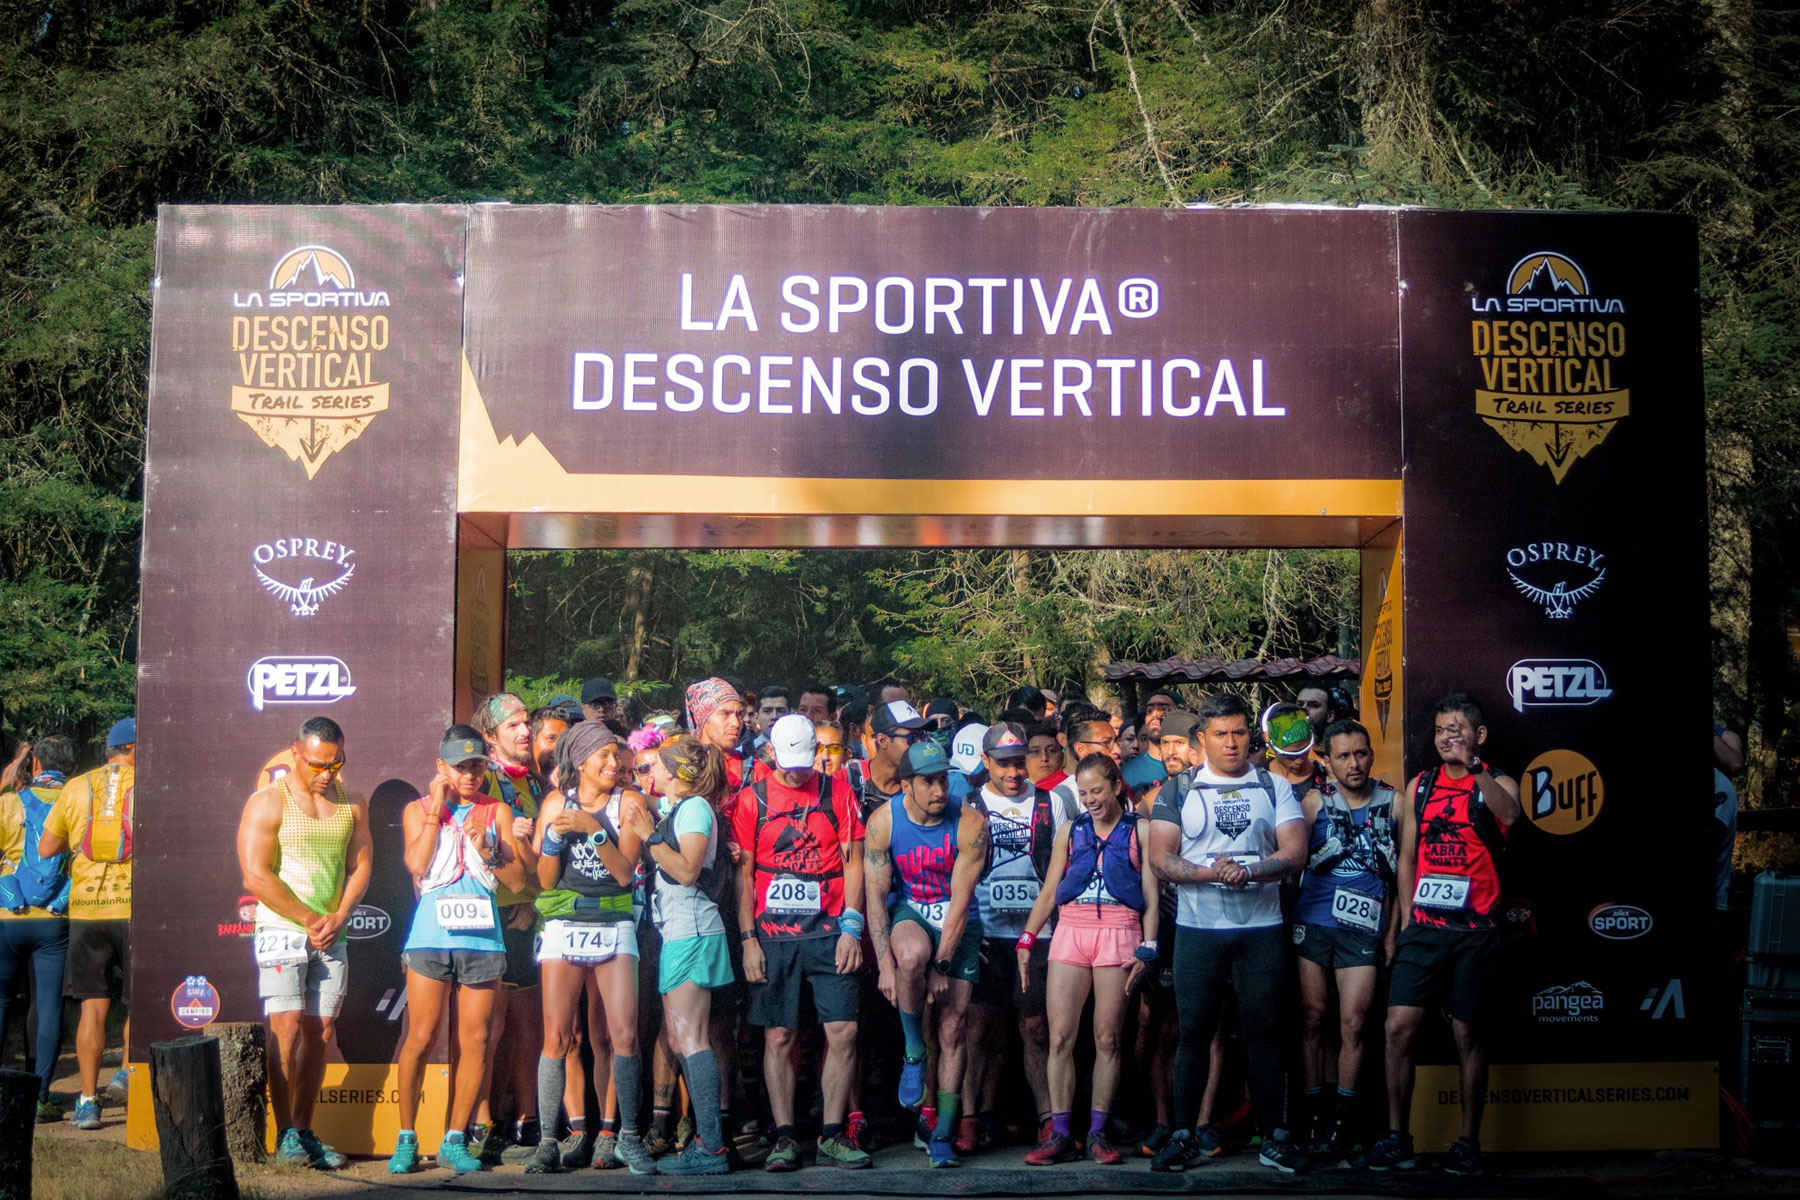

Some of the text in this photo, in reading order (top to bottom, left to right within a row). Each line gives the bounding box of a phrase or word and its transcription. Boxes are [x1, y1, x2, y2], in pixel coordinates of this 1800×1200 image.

[234, 292, 391, 307] LA SPORTIVA
[681, 273, 759, 333] LA
[1472, 298, 1625, 313] LA SPORTIVA
[232, 315, 390, 351] DESCENSO
[1472, 320, 1626, 358] DESCENSO
[239, 352, 381, 388] VERTICAL
[1480, 358, 1621, 394] VERTICAL
[572, 352, 1287, 417] DESCENSO VERTICAL
[249, 393, 374, 410] TRAIL SERIES
[1492, 397, 1615, 414] TRAIL SERIES
[254, 538, 356, 565] OSPREY
[1507, 542, 1606, 569] OSPREY
[253, 663, 357, 711] PETZL
[1512, 667, 1613, 713] PETZL
[1214, 804, 1251, 814] DESCENSO
[1216, 812, 1247, 822] VERTICAL
[1424, 844, 1467, 857] CABRA
[769, 883, 805, 900] 208
[992, 884, 1028, 900] 035
[1419, 882, 1453, 900] 073
[440, 903, 478, 919] 009
[1335, 894, 1370, 918] 028
[1594, 916, 1649, 930] SPORT
[258, 935, 289, 954] 221
[566, 931, 603, 949] 174
[1532, 994, 1604, 1016] pangea
[1538, 1014, 1599, 1023] movements
[1438, 1086, 1689, 1105] DEENSOVERTICALSERIES.COM
